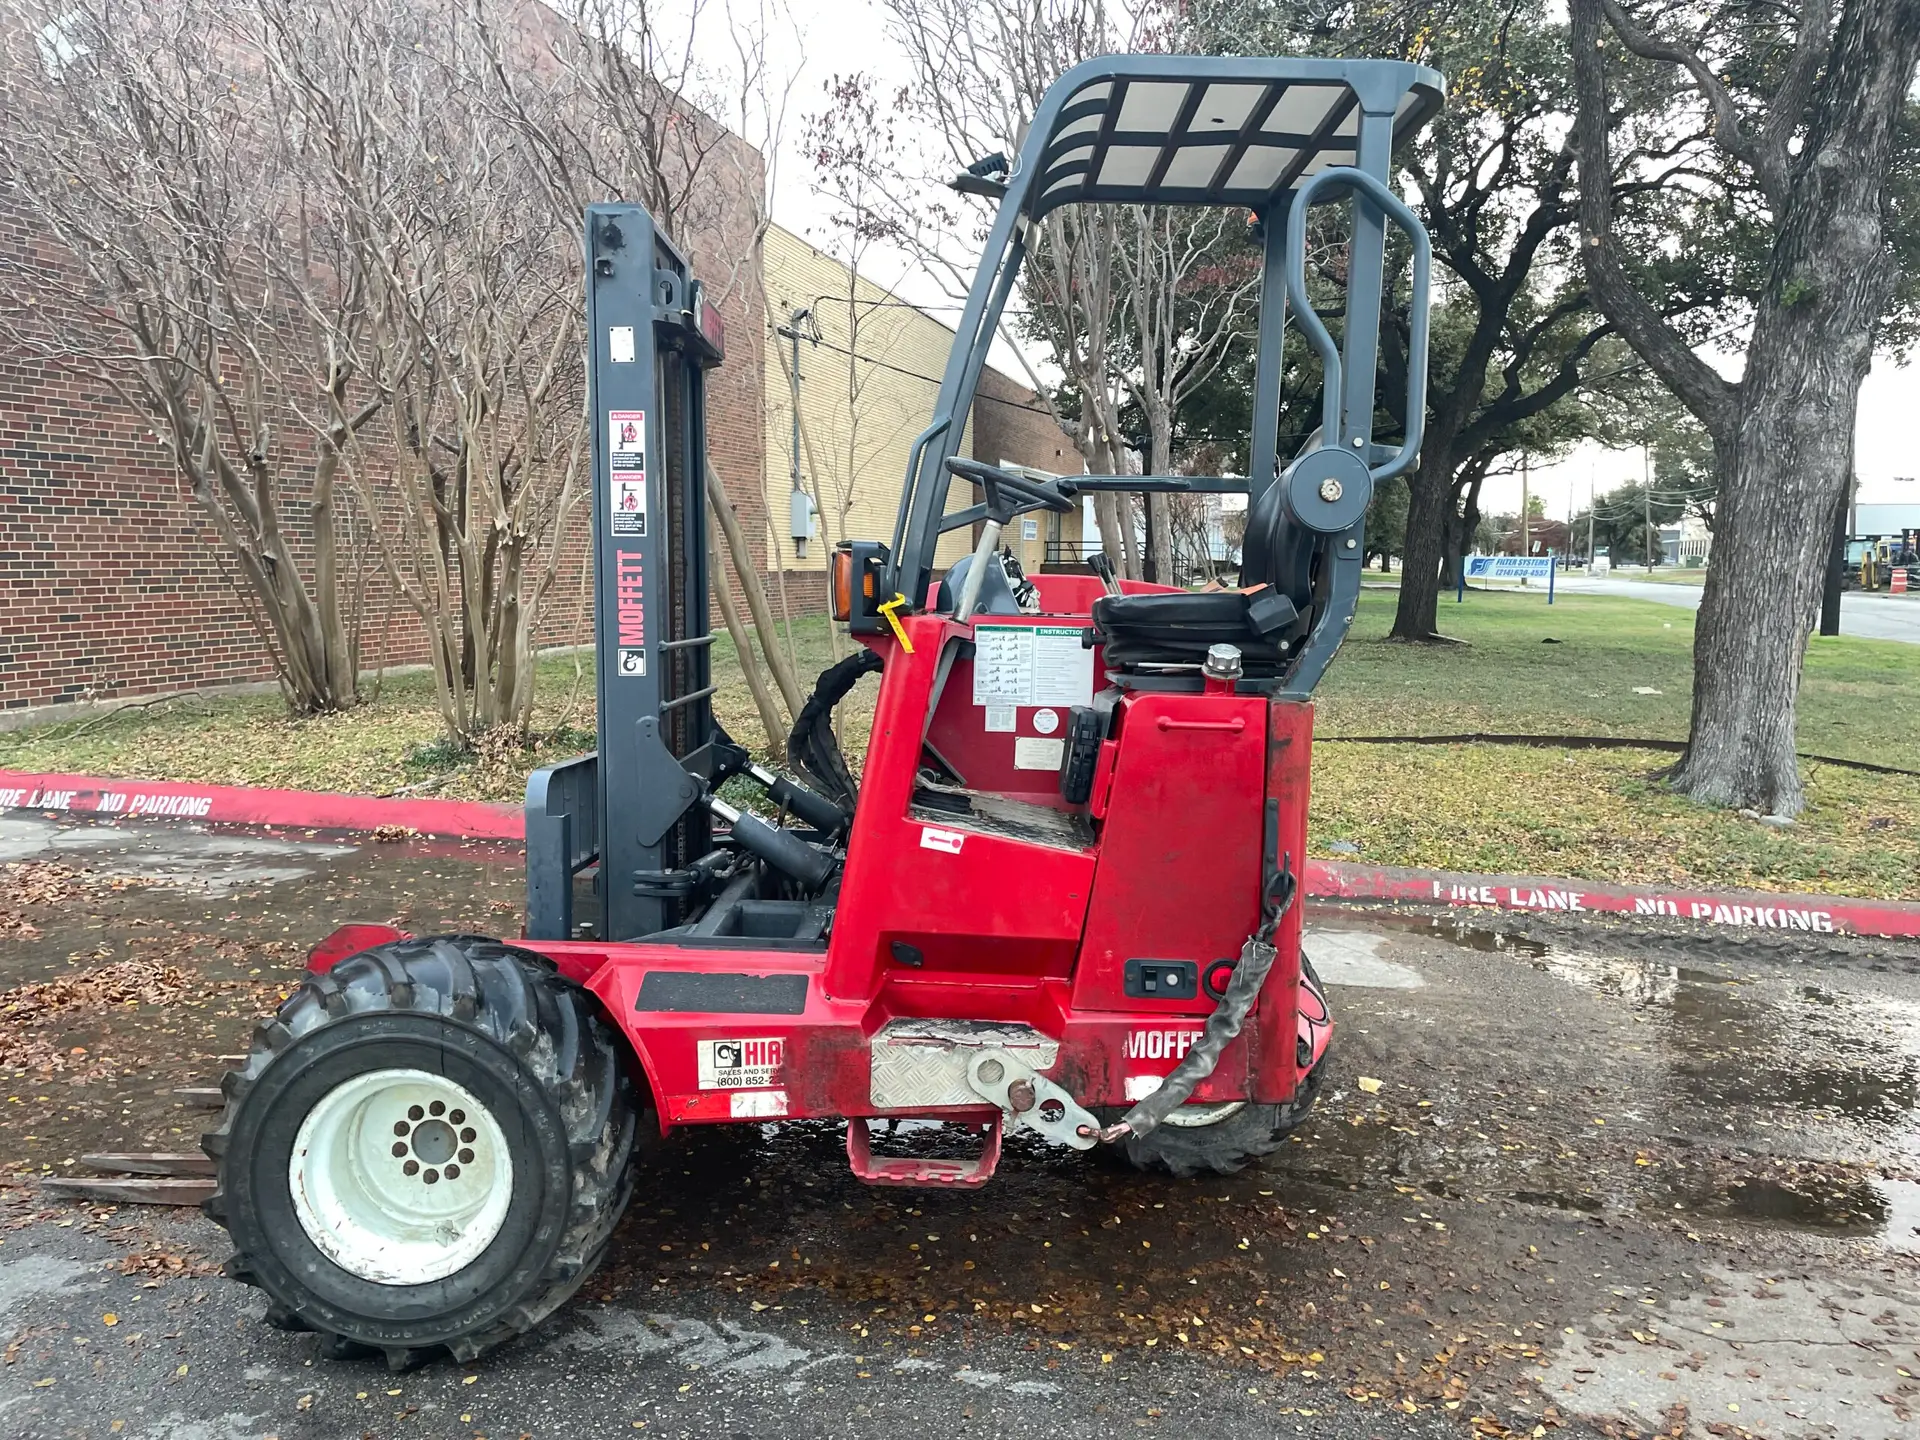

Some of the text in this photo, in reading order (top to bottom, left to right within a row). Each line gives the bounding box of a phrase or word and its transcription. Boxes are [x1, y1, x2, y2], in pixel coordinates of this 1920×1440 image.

[1517, 558, 1549, 566] SYSTEMS
[616, 549, 644, 646] MOFFETT
[26, 789, 77, 810] LANE
[96, 793, 213, 816] NO PARKING
[1510, 887, 1587, 912] LANE
[1691, 902, 1834, 933] PARKING
[717, 1075, 743, 1088] (800)
[718, 1069, 742, 1077] SALES
[743, 1068, 760, 1076] AND
